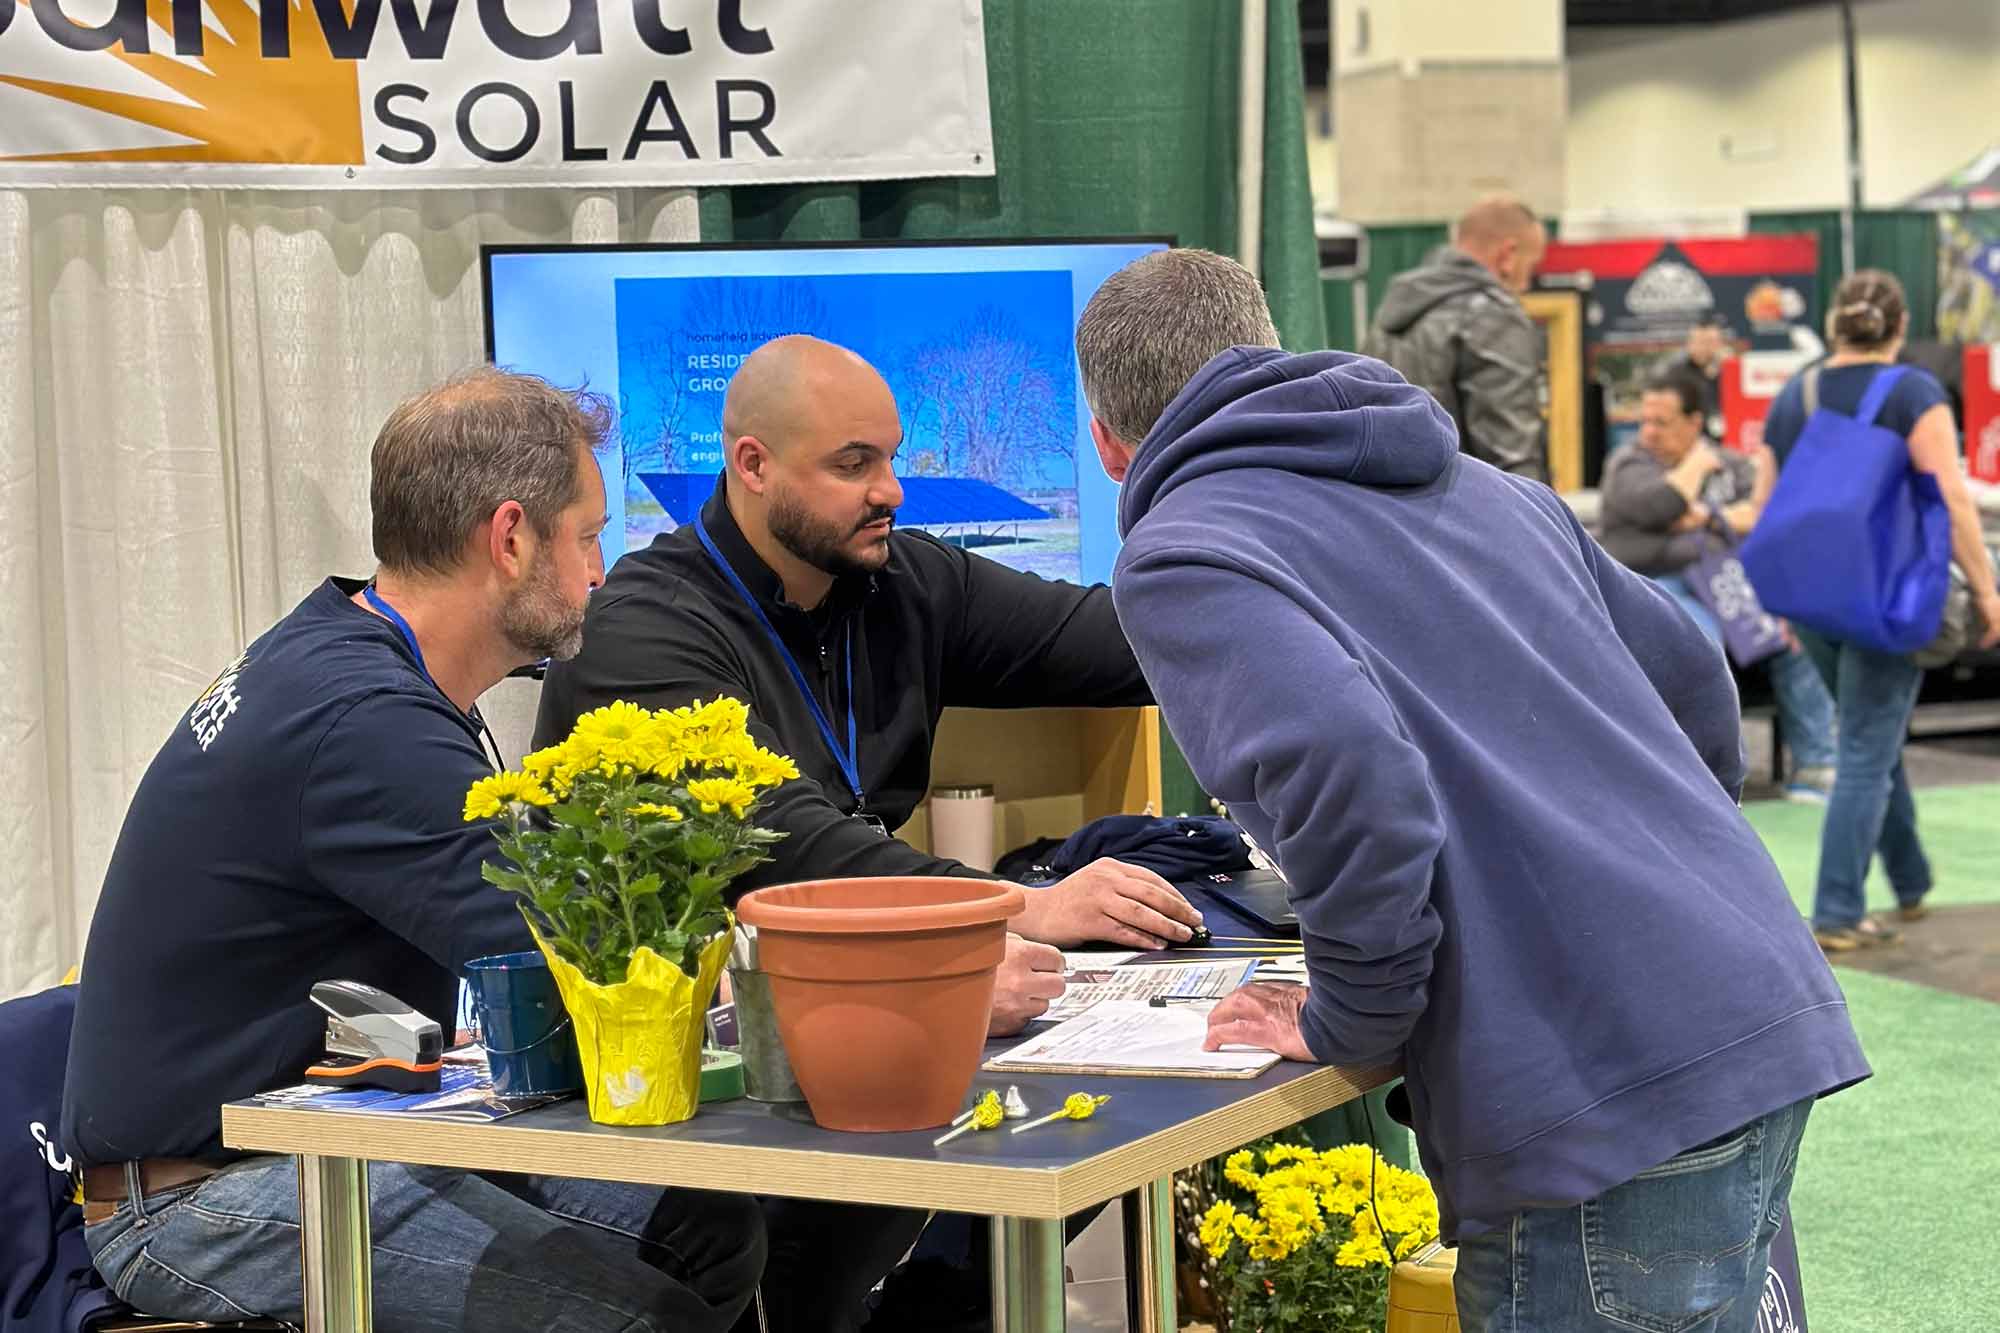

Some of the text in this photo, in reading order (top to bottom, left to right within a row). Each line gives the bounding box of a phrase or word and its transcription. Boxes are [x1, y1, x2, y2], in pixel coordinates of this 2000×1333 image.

[373, 79, 784, 165] SOLAR
[688, 377, 731, 393] GRO
[690, 431, 723, 443] Prof
[691, 452, 724, 464] engi
